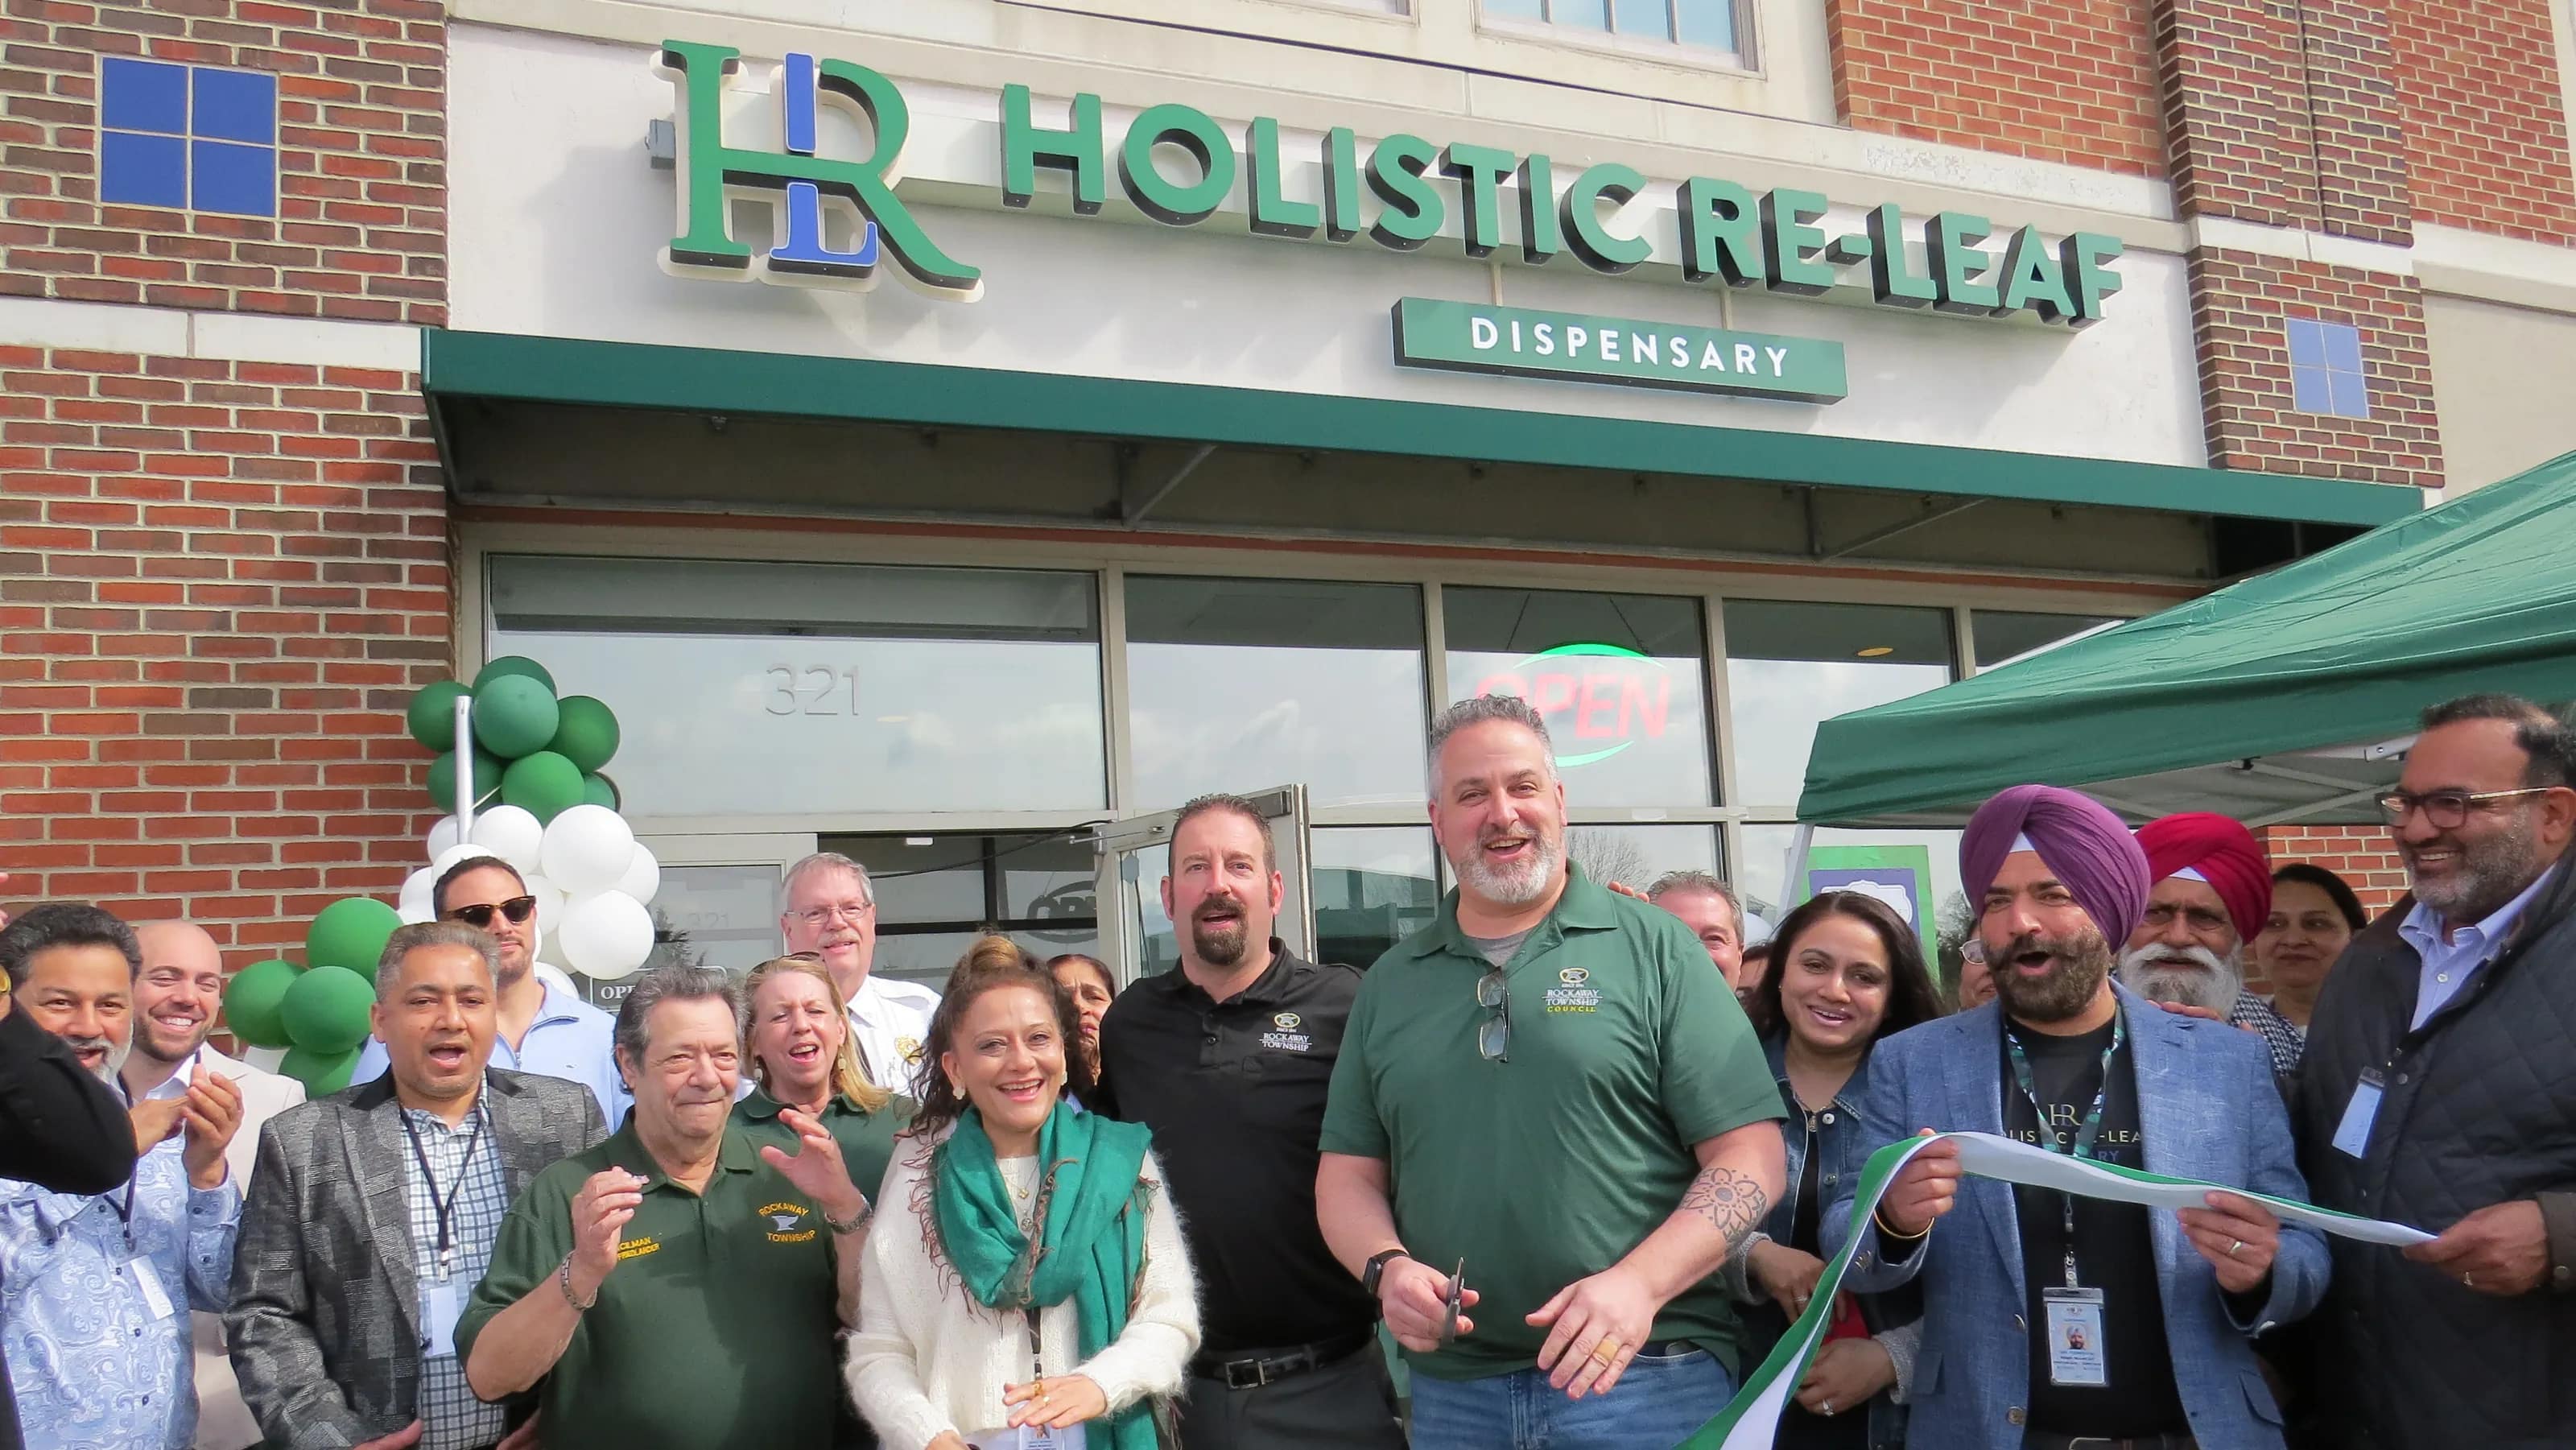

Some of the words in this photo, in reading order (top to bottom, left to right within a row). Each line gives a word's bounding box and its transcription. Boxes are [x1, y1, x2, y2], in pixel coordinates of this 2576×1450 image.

[1001, 83, 1653, 271] HOLISTIC
[1678, 176, 2125, 324] RE-LEAF
[1471, 315, 1790, 378] DISPENSARY
[766, 663, 859, 716] 321
[1546, 988, 1600, 998] ROCKAWAY
[1546, 998, 1600, 1006] TOWNSHIP
[1546, 1005, 1597, 1013] COUNCIL
[1263, 1032, 1310, 1043] ROCKAWAY
[1261, 1041, 1310, 1052] TOWNSHIP
[758, 1202, 810, 1217] ROCKAWAY
[766, 1229, 816, 1242] TOWNSHIP
[617, 1236, 651, 1251] CILMAN
